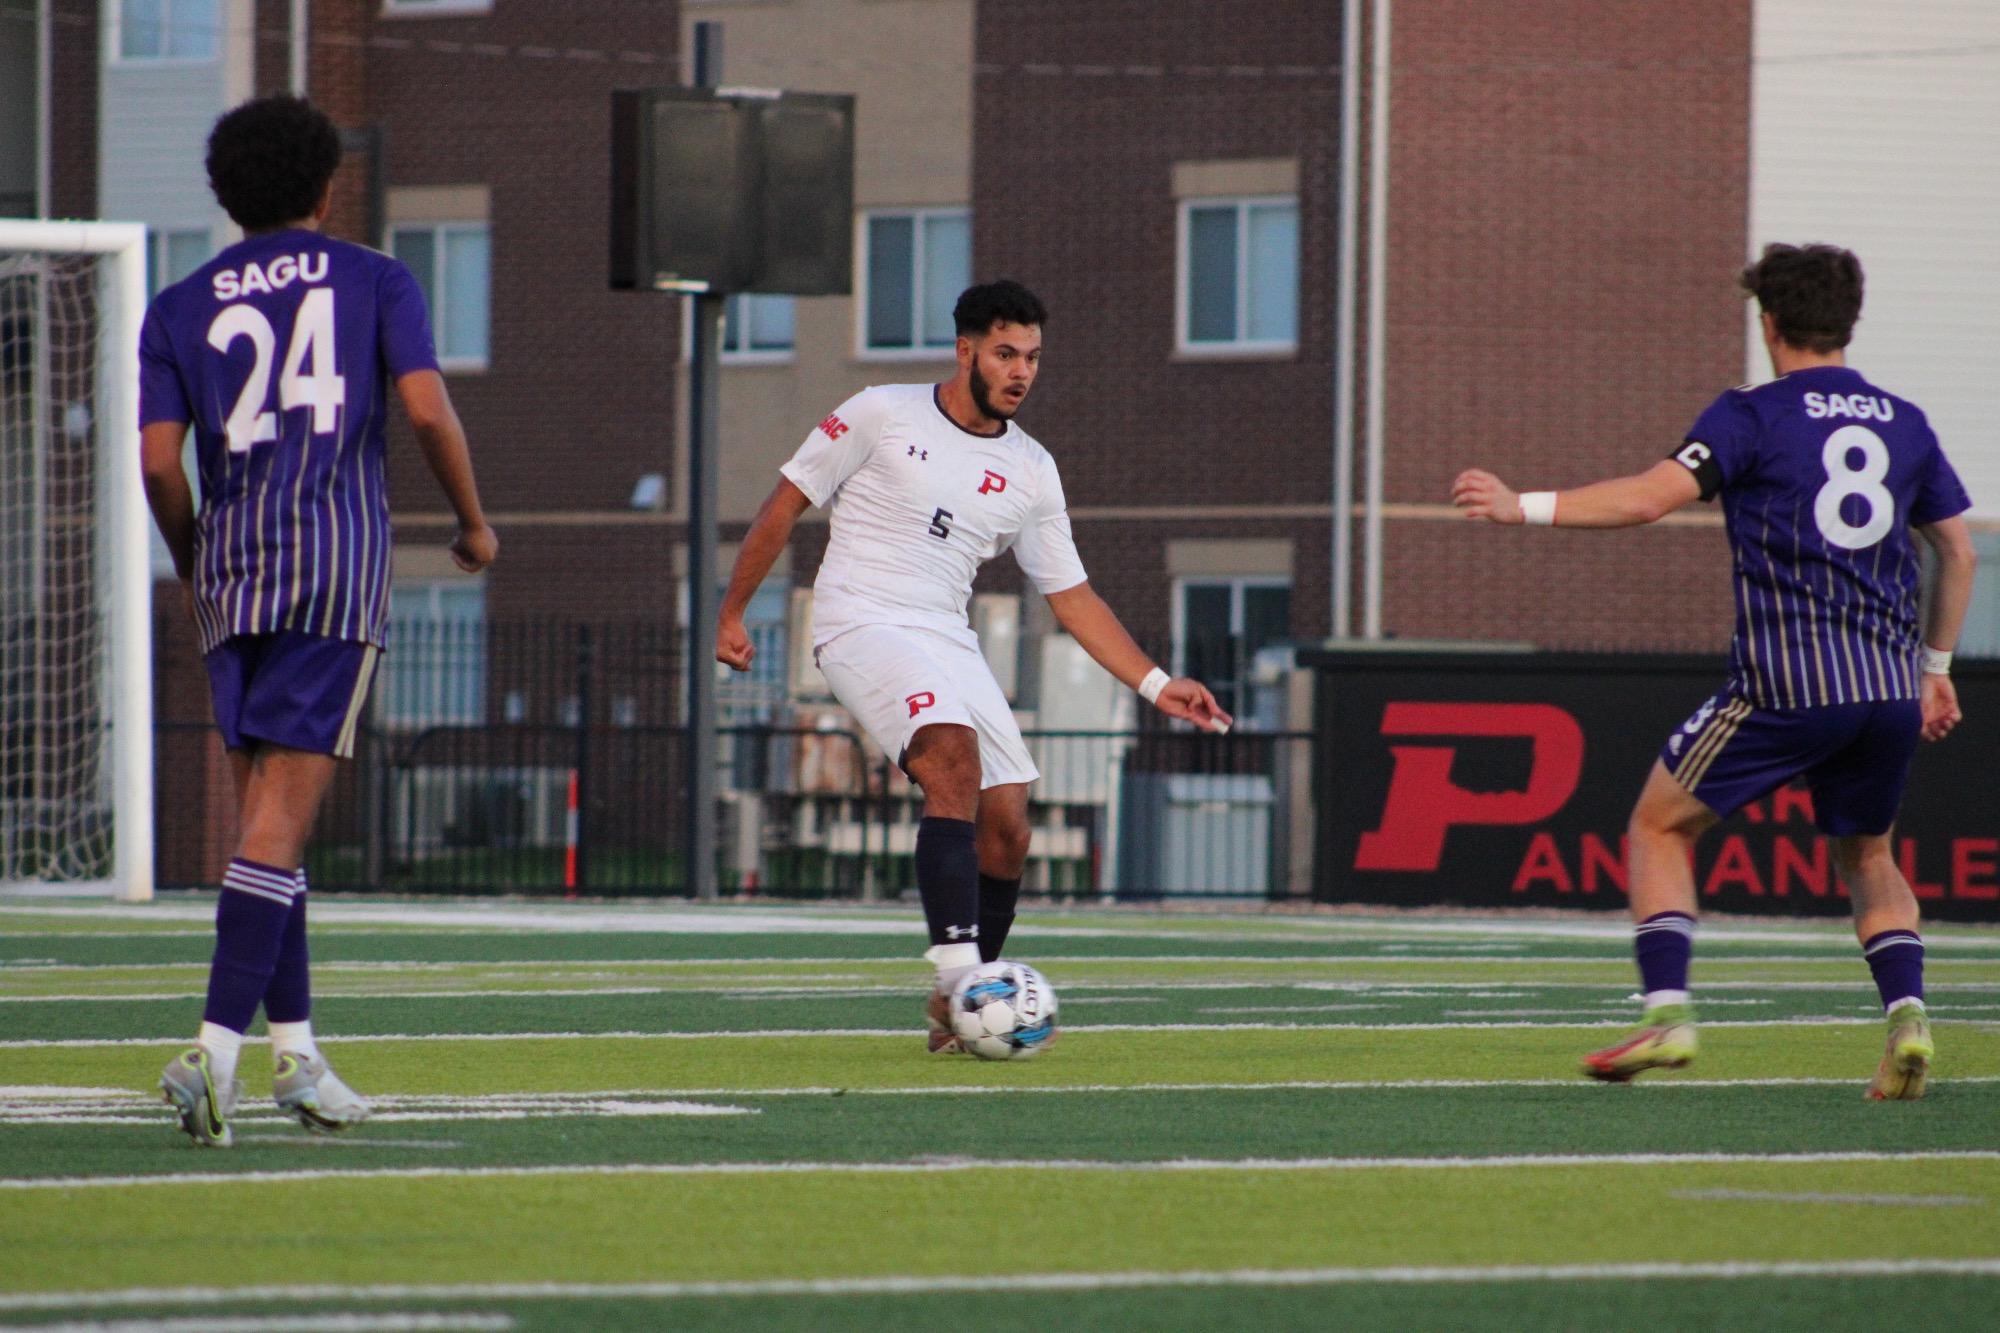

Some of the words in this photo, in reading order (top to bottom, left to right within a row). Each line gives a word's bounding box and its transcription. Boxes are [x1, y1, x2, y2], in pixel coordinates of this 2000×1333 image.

[212, 252, 329, 301] SAGU
[206, 287, 346, 453] 24
[1803, 391, 1895, 422] SAGU
[1676, 441, 1711, 470] C
[978, 469, 1007, 495] P
[1814, 425, 1895, 550] 8
[929, 507, 953, 539] 5
[905, 691, 935, 719] P
[1511, 831, 1999, 898] ANANLE
